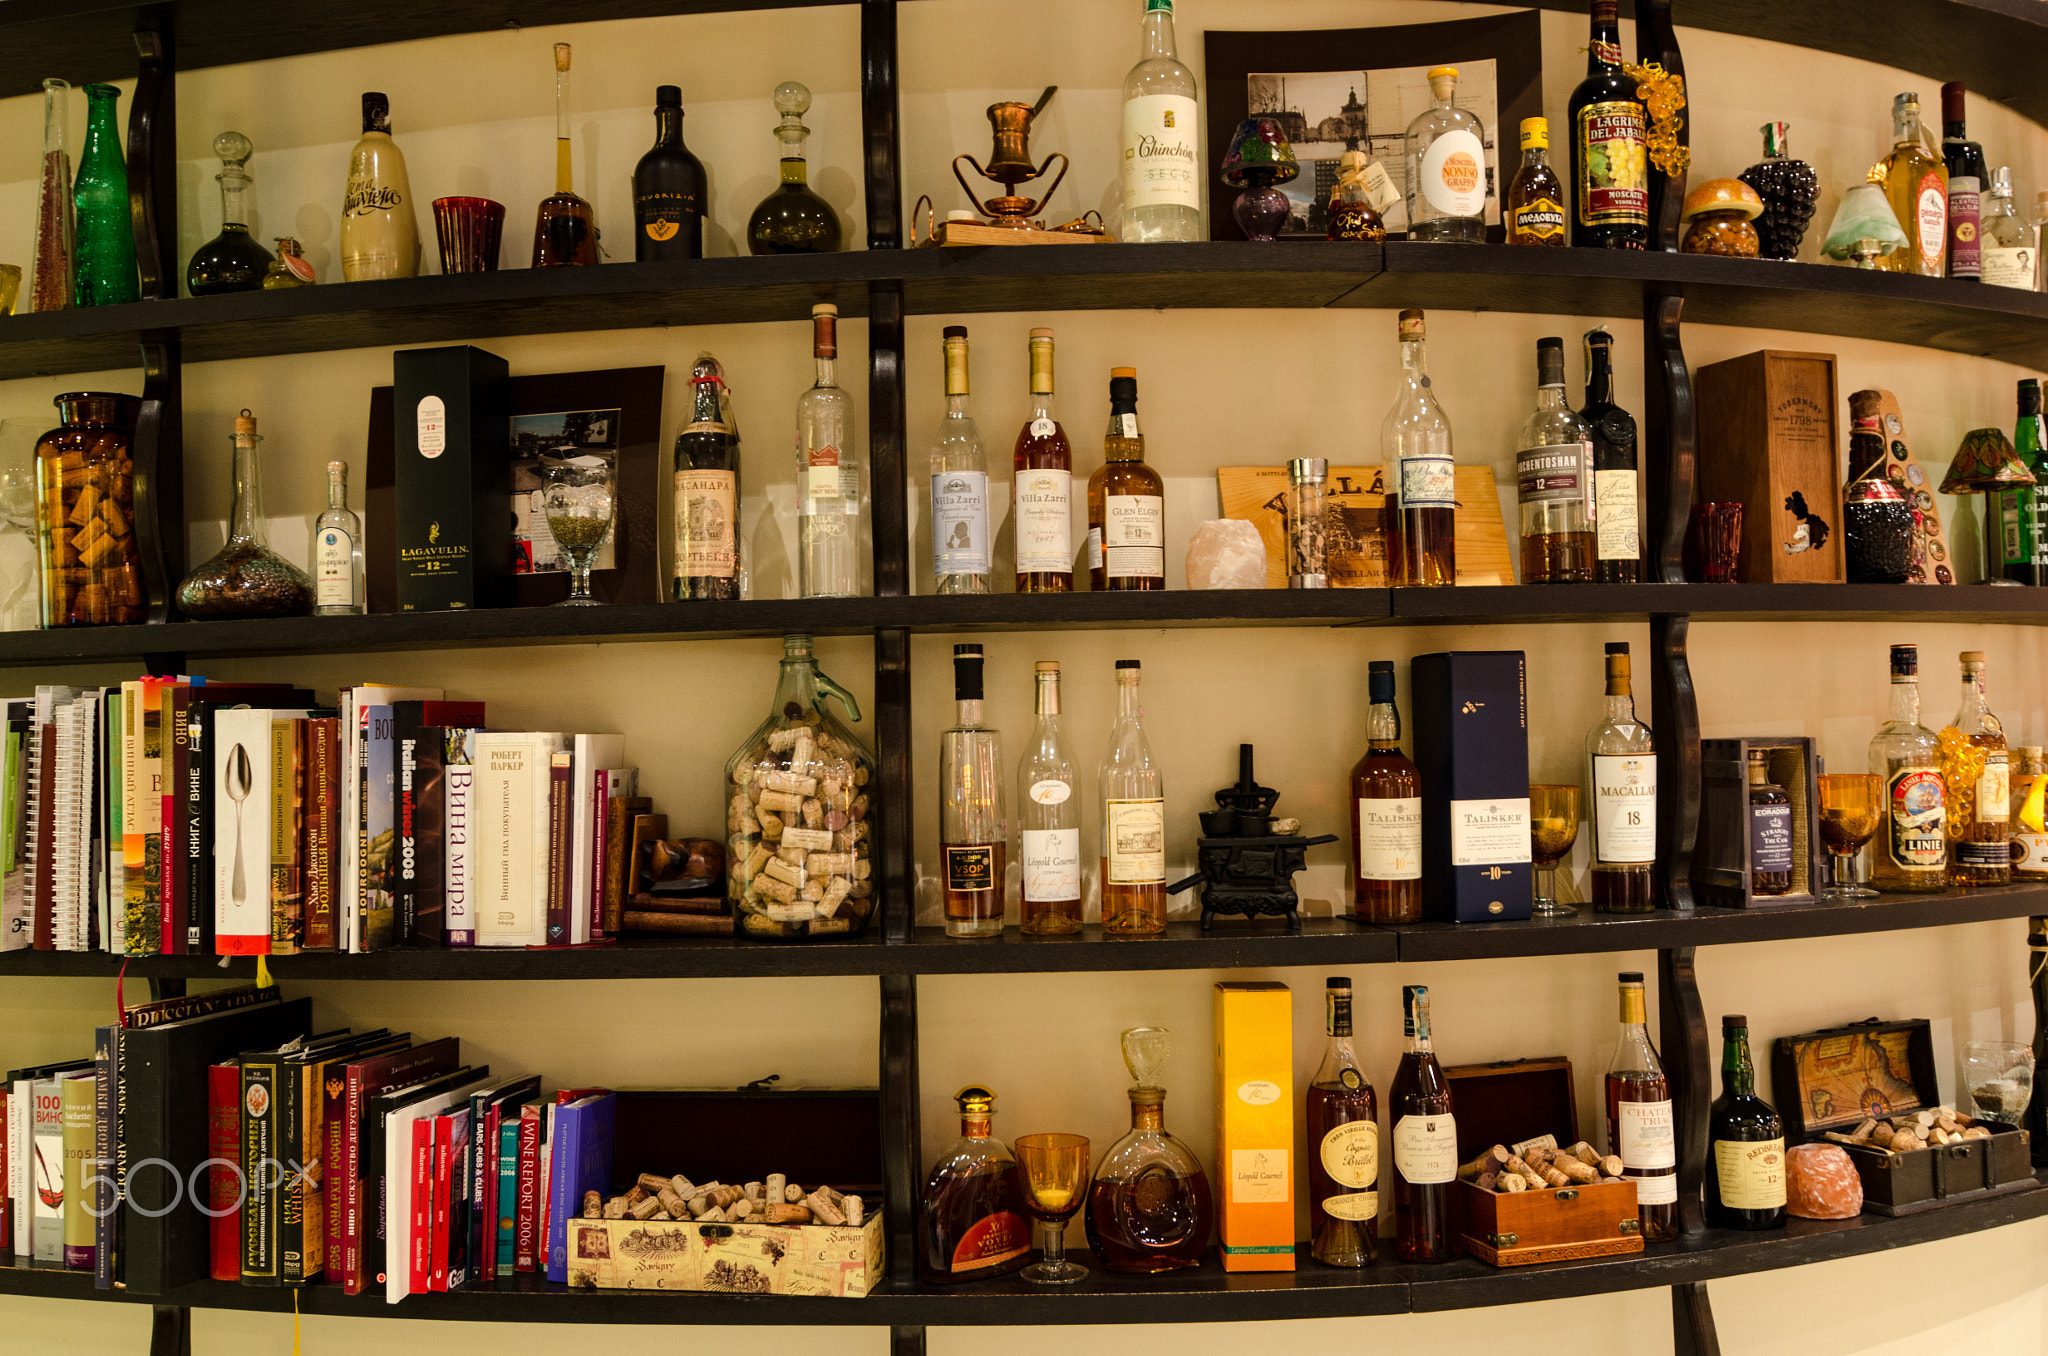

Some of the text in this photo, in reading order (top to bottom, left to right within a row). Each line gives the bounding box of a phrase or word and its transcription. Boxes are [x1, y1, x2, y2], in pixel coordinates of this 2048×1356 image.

[1591, 130, 1612, 140] DEL
[1148, 169, 1190, 181] SECO
[1443, 167, 1478, 178] NONINO
[1447, 178, 1475, 187] GRAPPA
[1790, 414, 1813, 426] 1798
[1535, 478, 1545, 490] 12
[936, 495, 981, 506] Villa Zarri
[1021, 493, 1067, 504] Villa Zarri
[1134, 528, 1142, 538] 12
[401, 545, 467, 557] LAGAVULIN
[426, 561, 441, 571] 12
[175, 710, 187, 745] ВИНО
[490, 750, 523, 760] РОБЕРТ
[490, 761, 524, 771] ПАРКЕР
[1900, 774, 1921, 792] LINIE
[189, 767, 200, 858] КНИГА ВИНЕ
[1464, 813, 1522, 824] TALISKER
[1627, 811, 1641, 826] 18
[316, 727, 330, 914] Большая Винная Энциклопедия
[447, 769, 473, 917] Вина мира
[500, 780, 511, 901] Винный гид покупателя
[1908, 840, 1942, 850] LINIE
[308, 829, 320, 905] Хью Джонсон
[359, 829, 367, 917] BOURGOGNE
[954, 864, 984, 874] VSOP
[1489, 866, 1501, 880] 10
[117, 1075, 127, 1115] ARMS
[349, 1078, 357, 1143] ДЕГУСТАЦИИ
[96, 1067, 108, 1170] ЗАМКИ ДВОРЦЫ
[65, 1149, 92, 1159] 2005
[475, 1147, 484, 1168] PUBS
[117, 1139, 127, 1201] ARMOUR
[348, 1145, 356, 1204] ИСКУССТВО
[475, 1169, 483, 1177] &
[1238, 1171, 1259, 1181] Léopold
[520, 1122, 536, 1246] WINE REPORT 2006
[1767, 1175, 1777, 1184] 12
[474, 1177, 483, 1202] CLUBS
[283, 1170, 292, 1224] ВИСКИ
[291, 1170, 302, 1225] WHISKY
